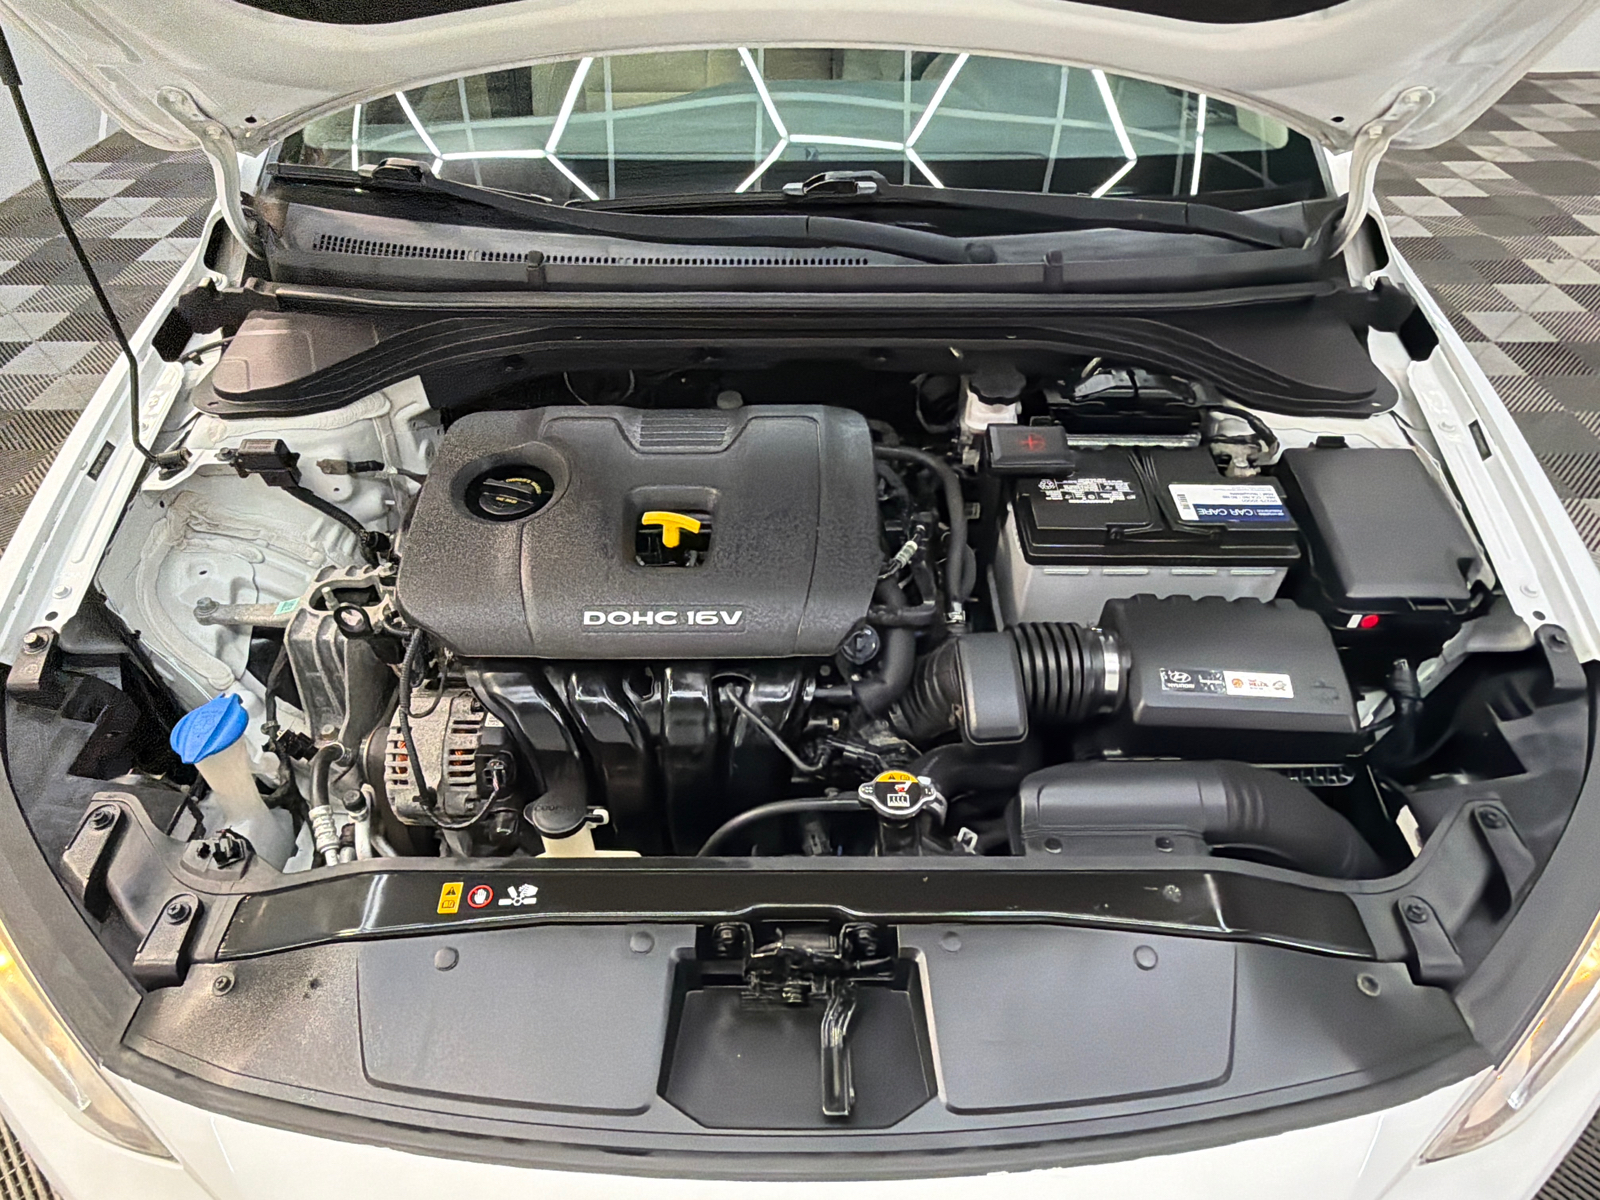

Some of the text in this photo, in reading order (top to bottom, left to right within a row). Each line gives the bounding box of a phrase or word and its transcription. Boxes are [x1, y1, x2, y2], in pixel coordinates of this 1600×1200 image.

[1197, 508, 1227, 516] CARE
[1229, 508, 1254, 516] CAR
[583, 610, 743, 626] DOHC 16V
